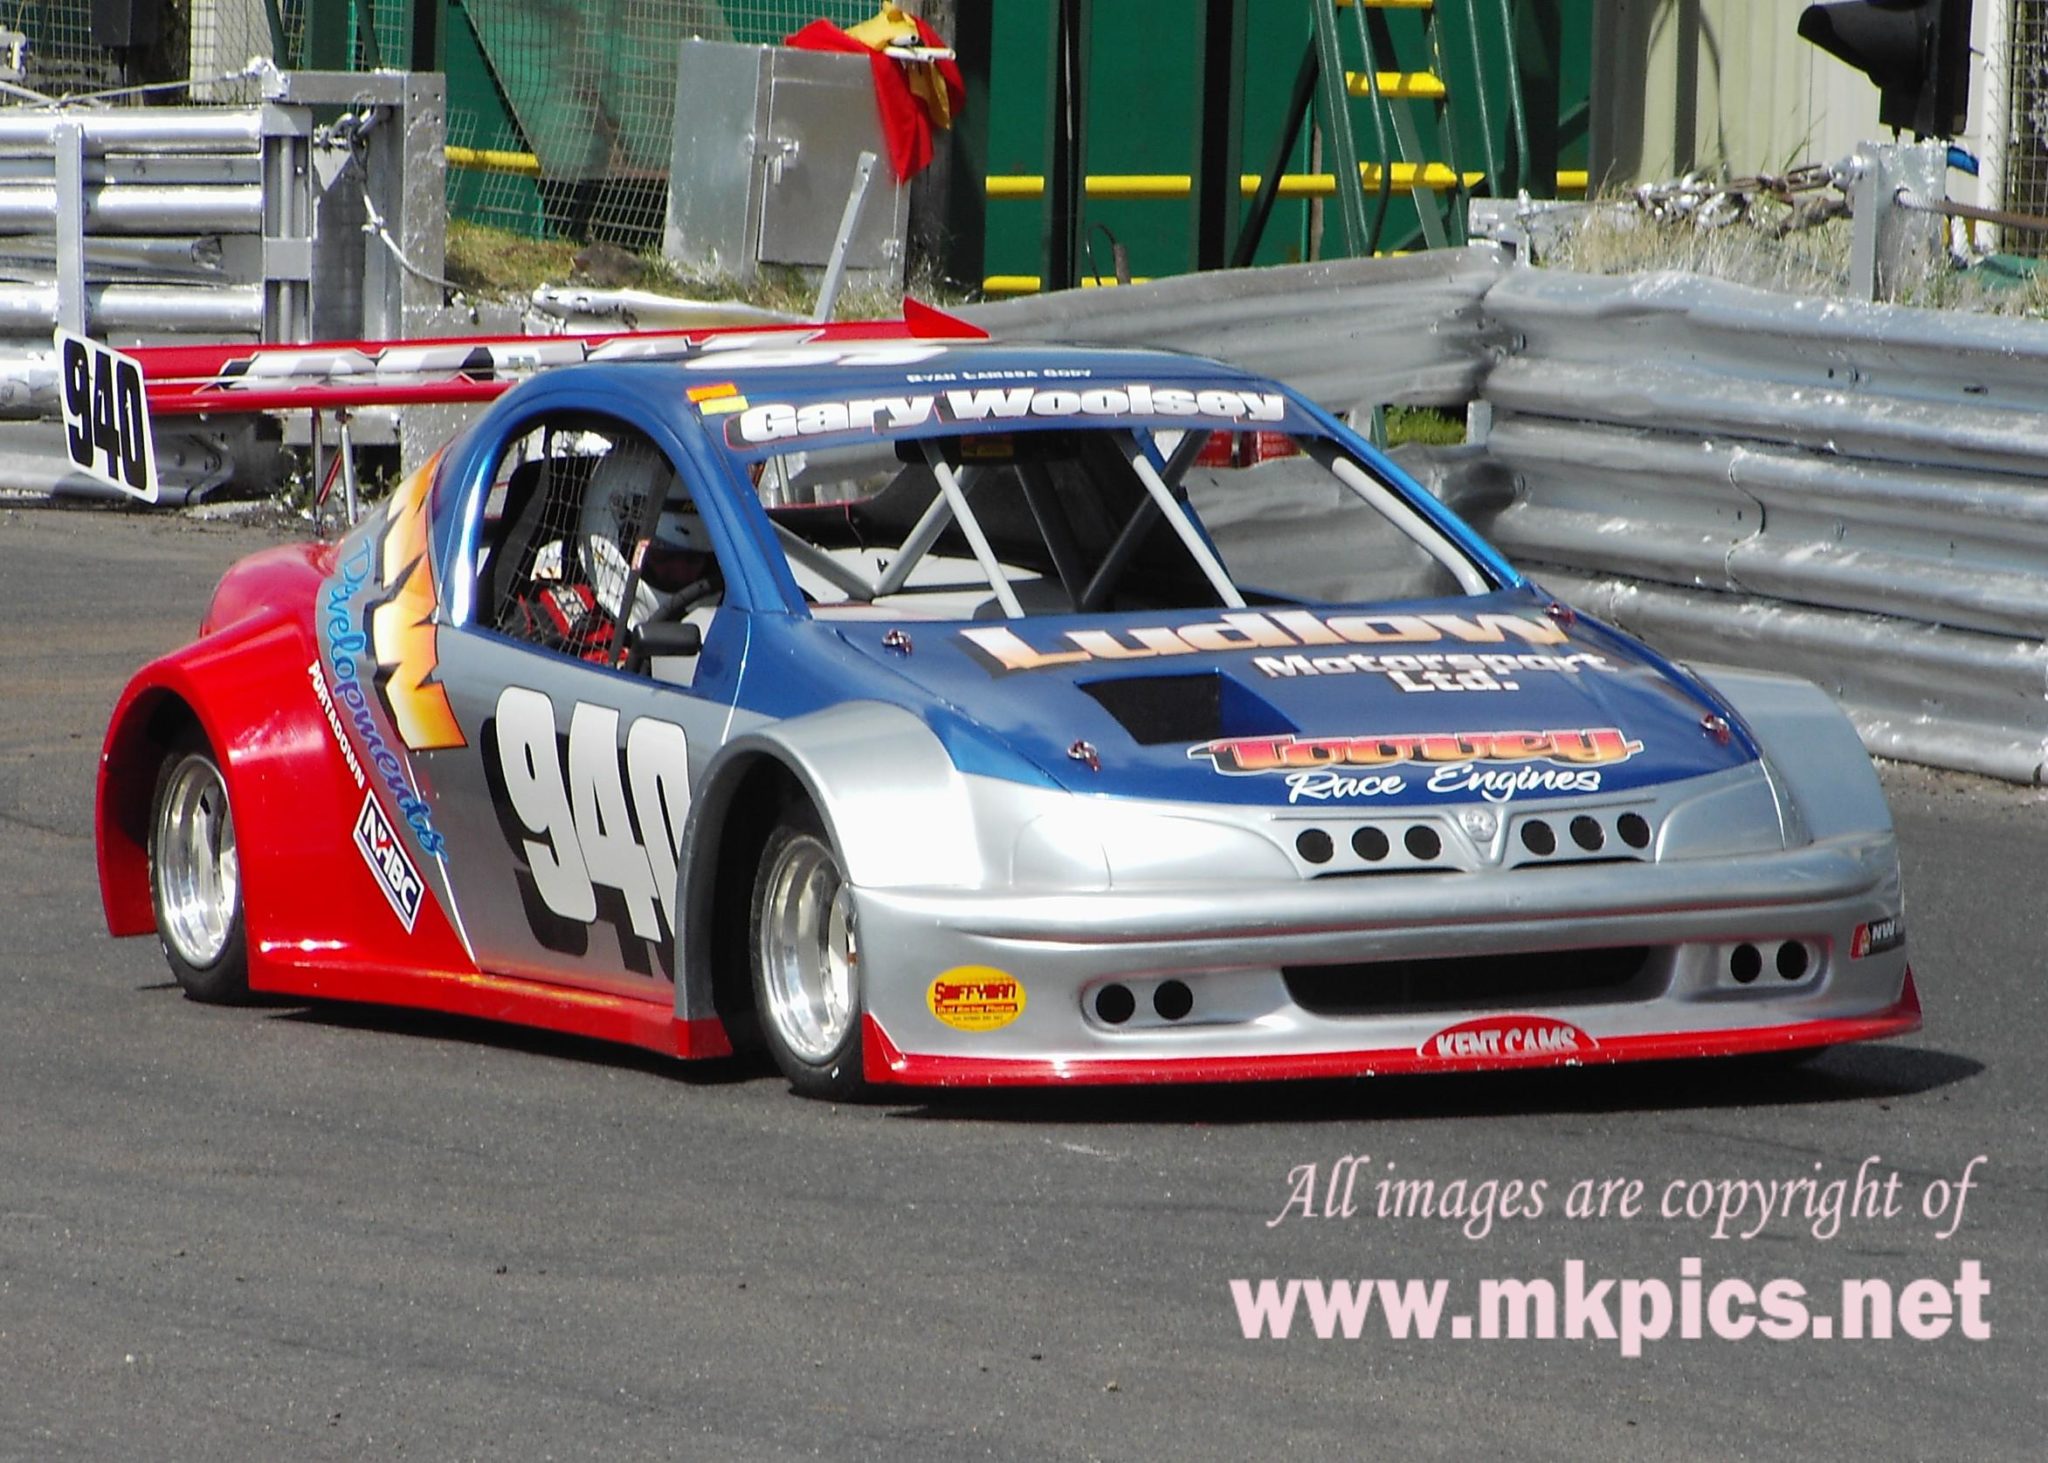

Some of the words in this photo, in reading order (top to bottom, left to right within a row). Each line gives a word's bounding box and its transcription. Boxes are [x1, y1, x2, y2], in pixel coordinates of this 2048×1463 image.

[64, 338, 147, 491] 940
[738, 395, 936, 442] Gary
[945, 385, 1284, 422] Woolsey
[962, 611, 1568, 670] Ludlow
[1254, 653, 1618, 678] Motorsport
[1386, 670, 1521, 694] Ltd.
[307, 659, 365, 790] PORTADOWN
[1286, 774, 1406, 804] Race
[1427, 763, 1601, 802] Engines
[496, 685, 691, 943] 940
[363, 806, 418, 914] NHBC
[1437, 1031, 1500, 1057] KENT
[1505, 1028, 1575, 1055] CAMS
